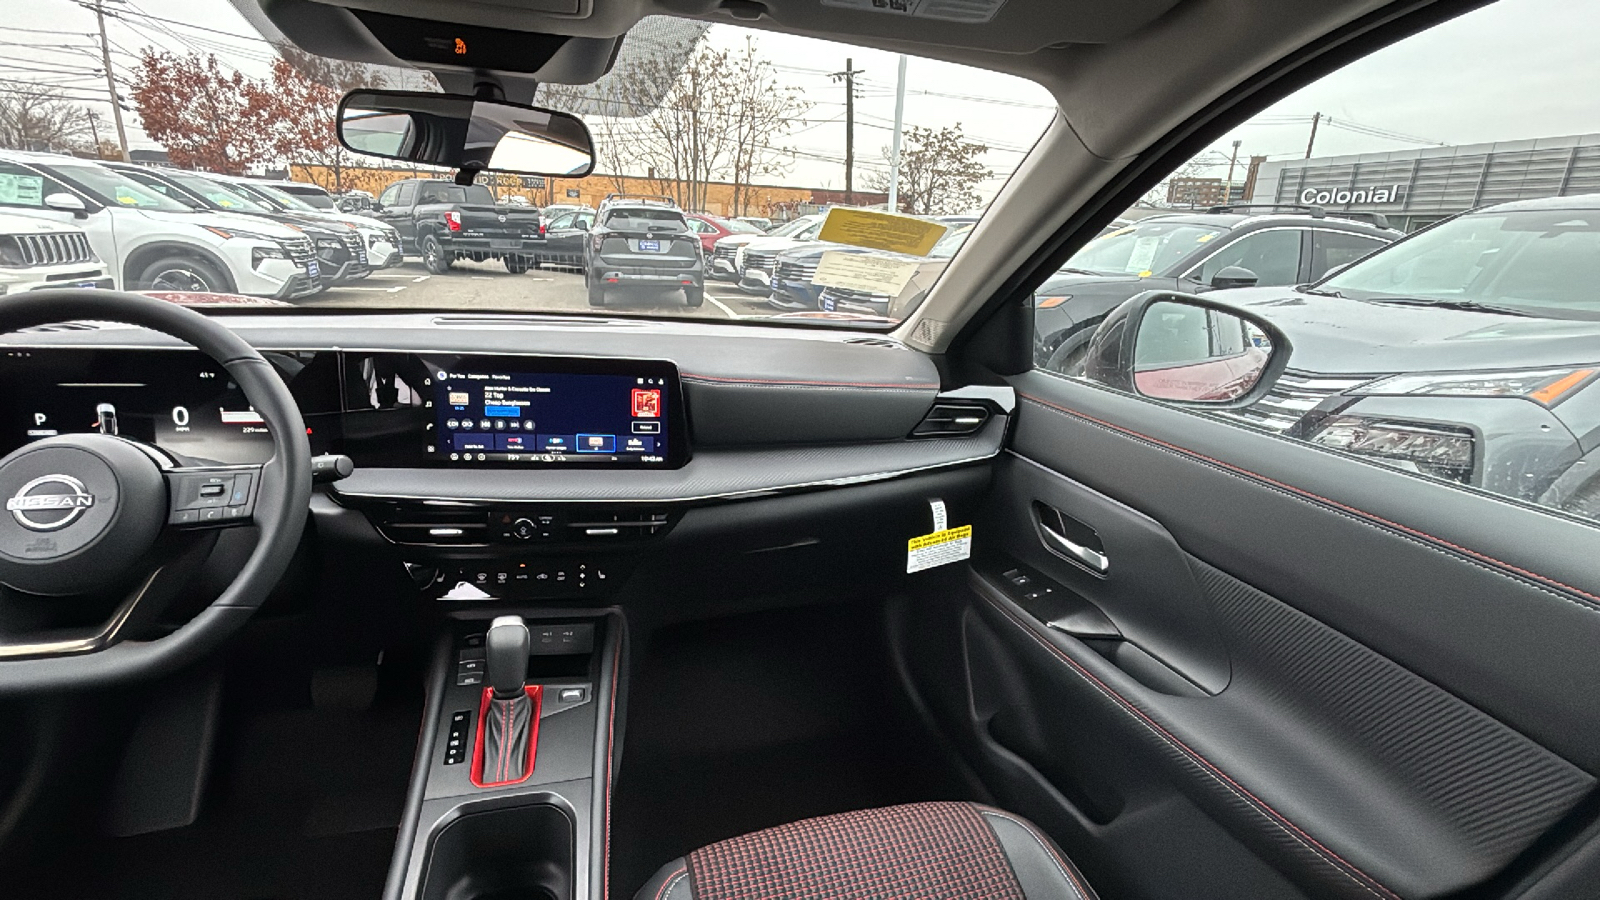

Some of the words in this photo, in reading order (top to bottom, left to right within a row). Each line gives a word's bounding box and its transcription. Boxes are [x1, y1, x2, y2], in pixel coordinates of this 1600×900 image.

[1301, 184, 1399, 205] Colonial
[34, 412, 47, 426] P
[172, 406, 190, 426] 0
[8, 495, 93, 510] NISSAN
